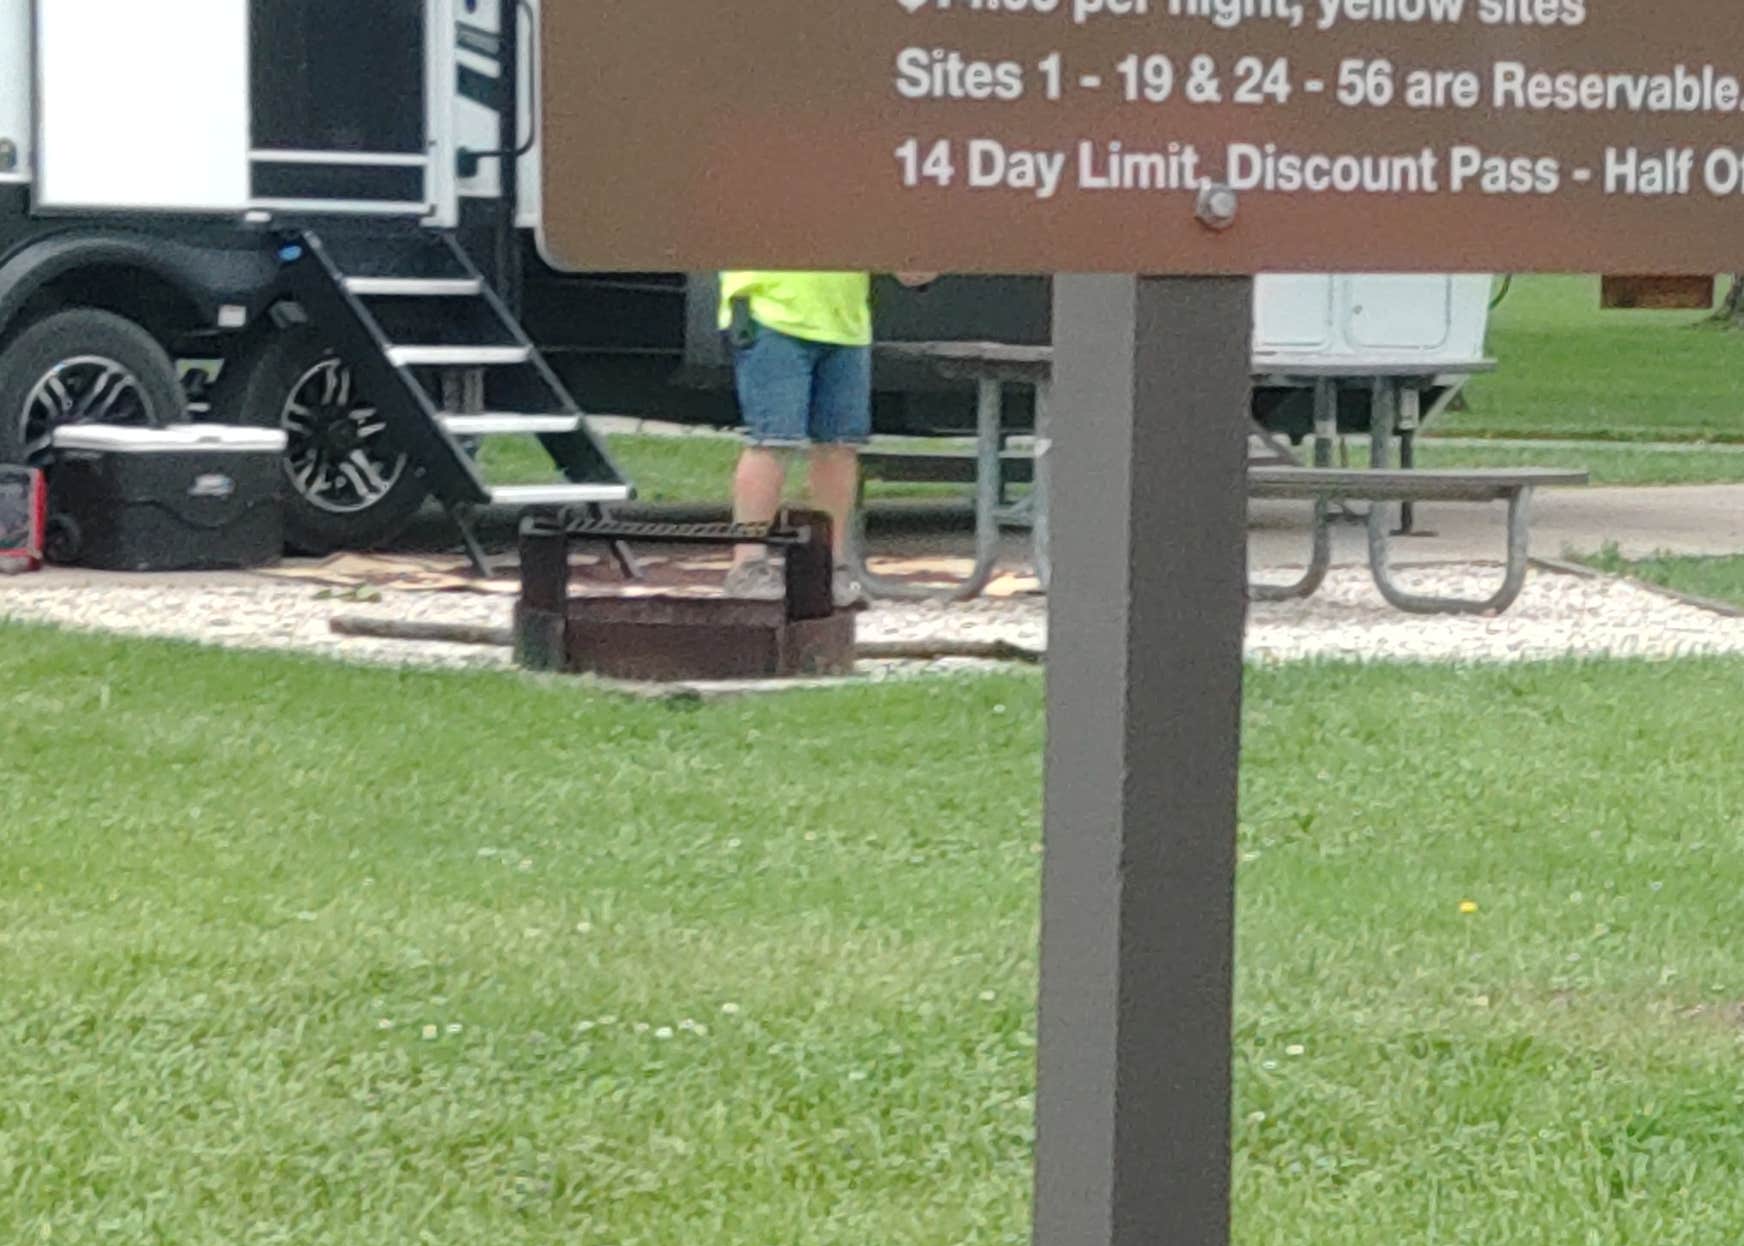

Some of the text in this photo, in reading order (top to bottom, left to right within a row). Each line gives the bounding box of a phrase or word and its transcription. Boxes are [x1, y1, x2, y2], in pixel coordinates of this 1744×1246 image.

[896, 48, 1023, 99] Sites
[1038, 53, 1060, 98] 1
[1080, 75, 1101, 87] -
[1117, 54, 1174, 102] 19
[1185, 55, 1222, 103] &
[1234, 56, 1292, 103] 24
[1305, 79, 1324, 92] -
[1337, 58, 1394, 107] 56
[1405, 71, 1479, 107] are
[895, 138, 955, 186] 14
[968, 139, 1065, 198] Day
[1227, 143, 1438, 192] Discount
[1450, 146, 1560, 193] Pass
[1573, 168, 1591, 181] -
[1604, 147, 1694, 194] Half
